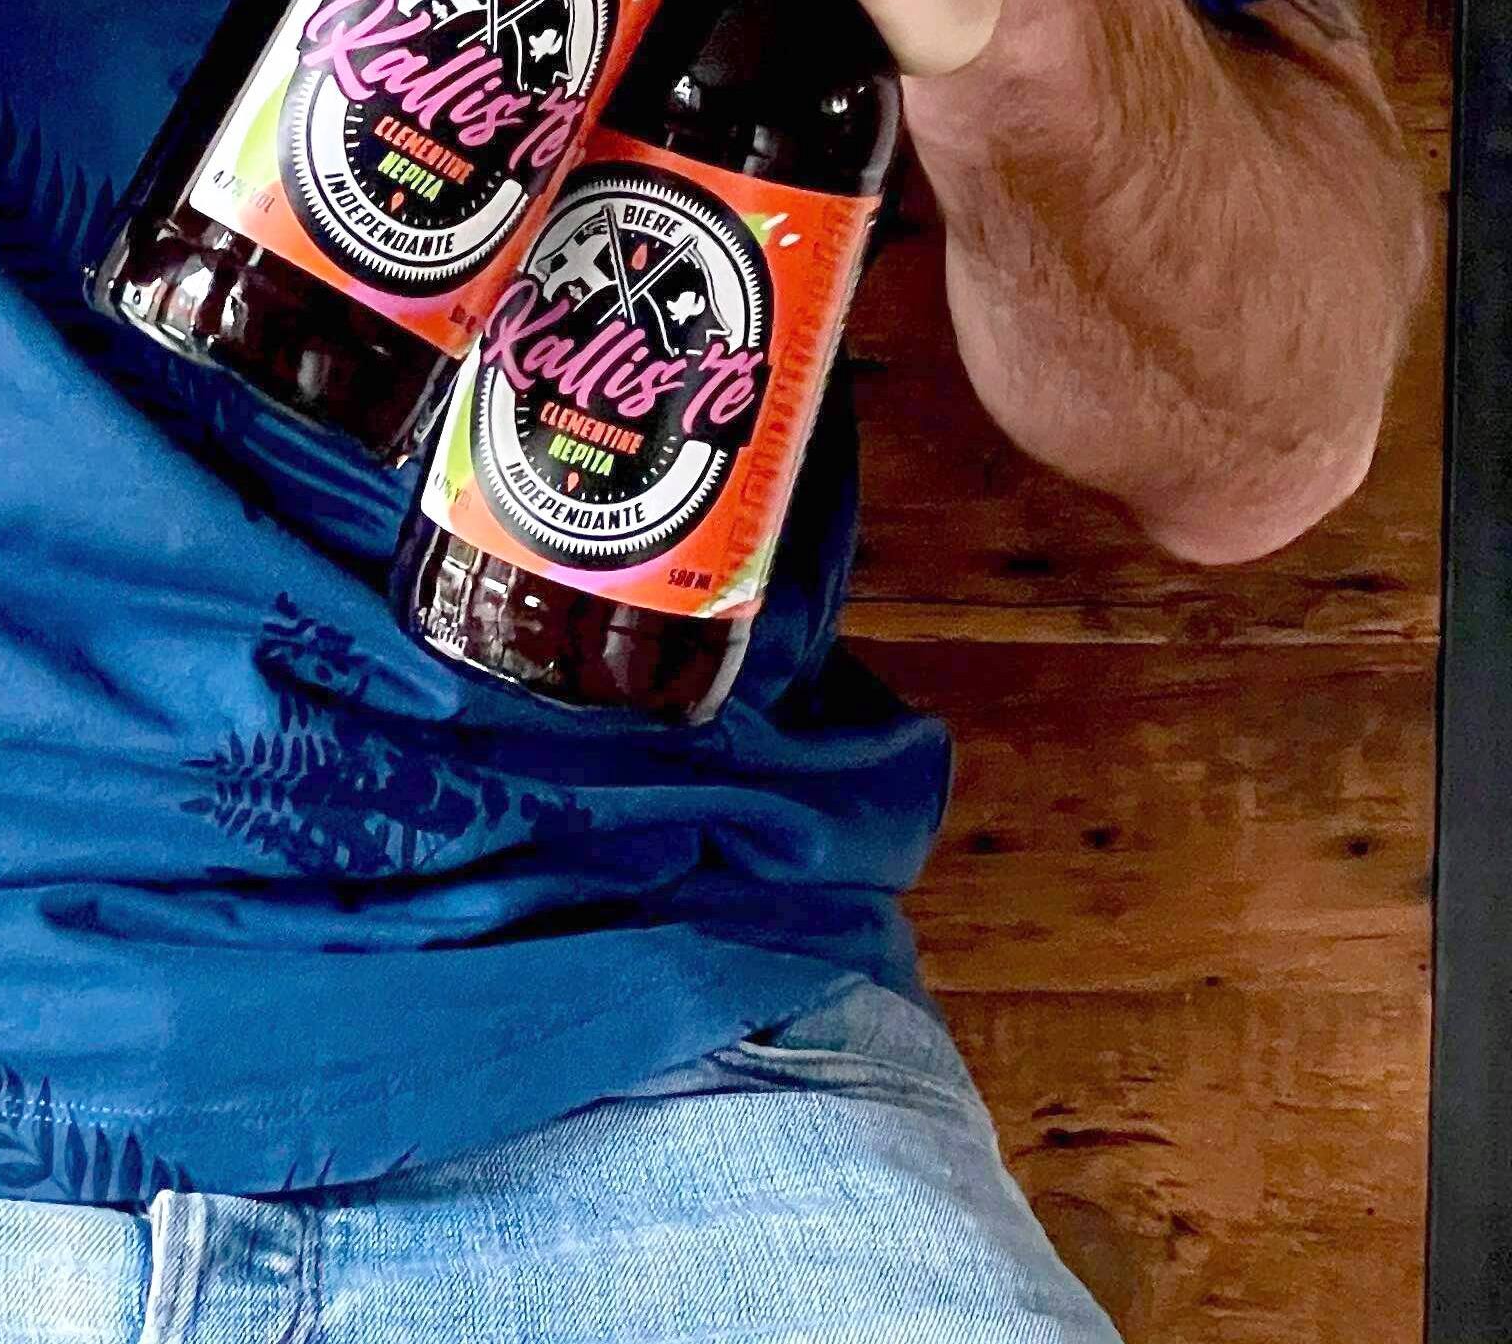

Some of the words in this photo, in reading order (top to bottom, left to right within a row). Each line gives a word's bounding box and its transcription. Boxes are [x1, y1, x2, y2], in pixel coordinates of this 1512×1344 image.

[377, 151, 444, 203] NEPITA
[324, 172, 455, 256] INDEPENDANTE
[623, 204, 683, 237] BIERE
[540, 401, 645, 455] CLEMENTINE
[548, 433, 615, 477] NEPITA
[506, 461, 646, 530] INDEPENDANTE
